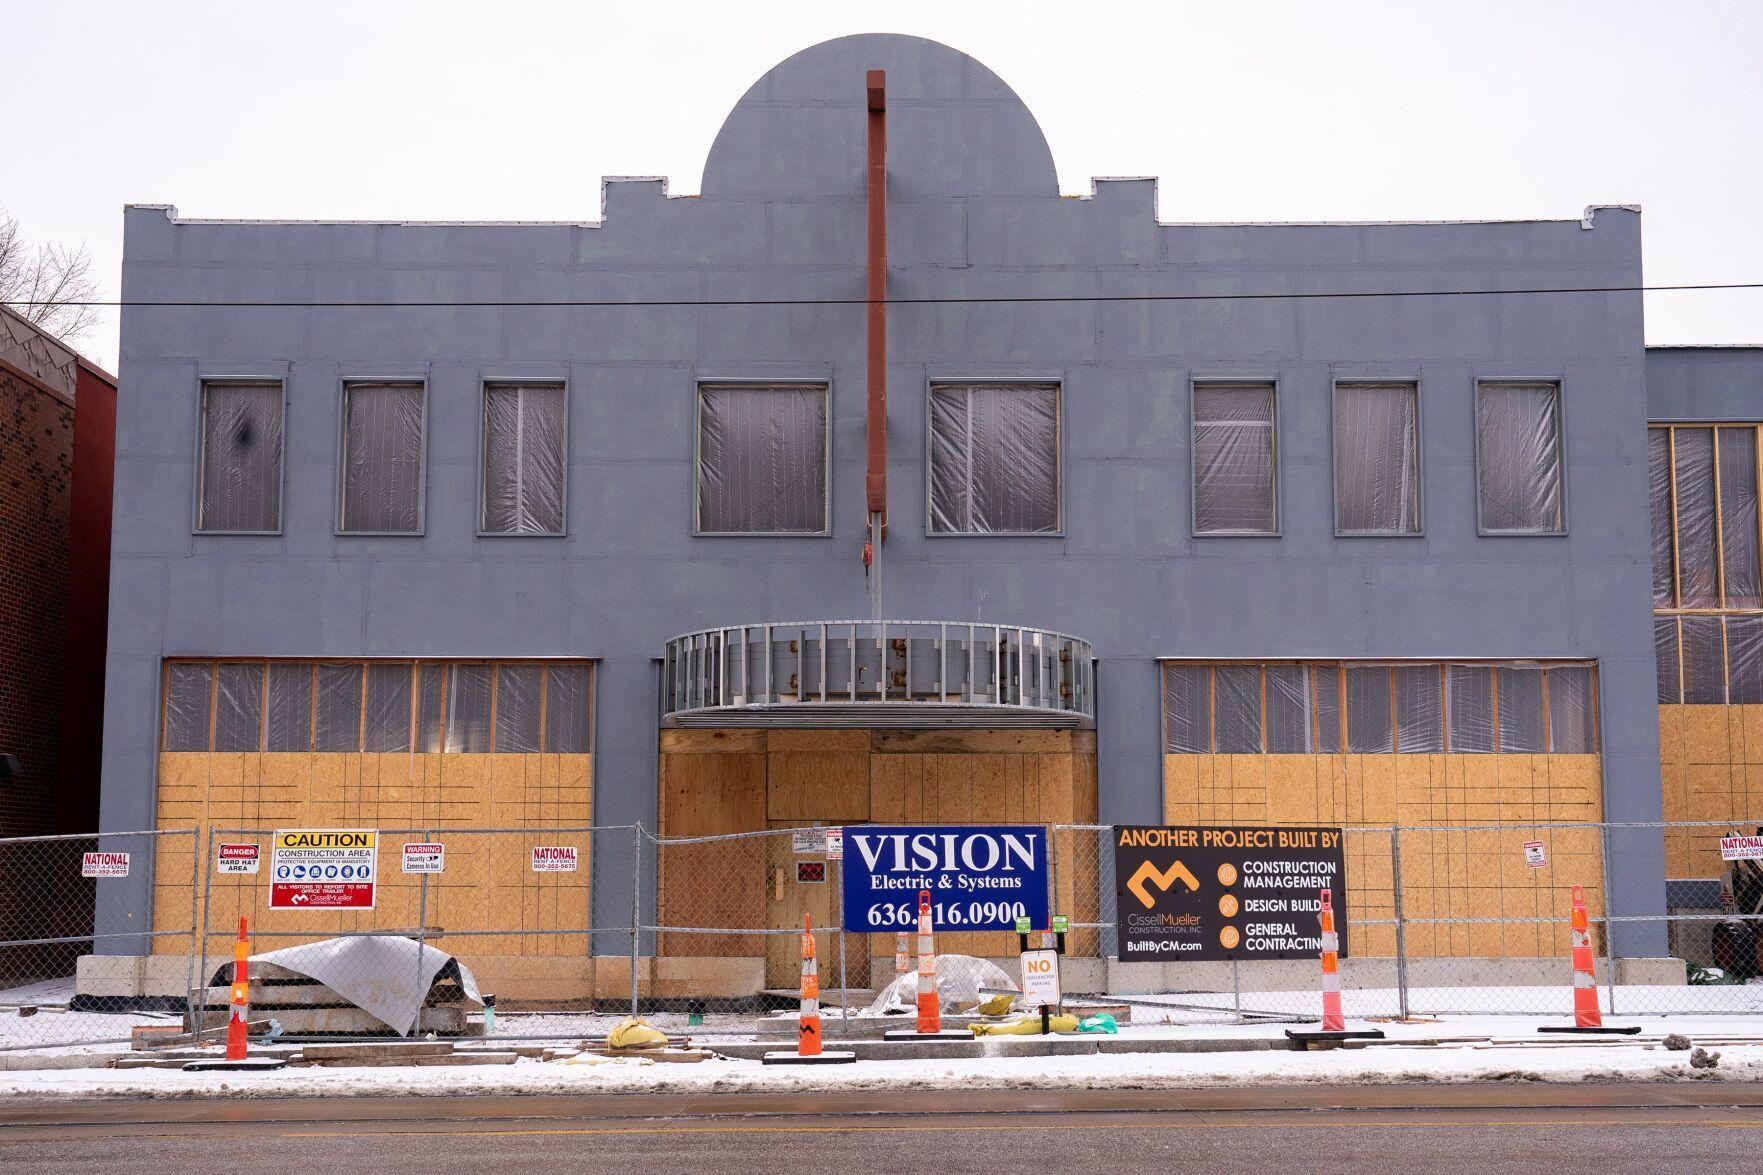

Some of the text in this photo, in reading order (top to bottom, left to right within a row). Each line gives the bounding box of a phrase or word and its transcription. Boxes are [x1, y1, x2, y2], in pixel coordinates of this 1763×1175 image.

[284, 834, 368, 847] CAUTION
[1119, 829, 1339, 848] ANOTHER PROJECT BUILT BY
[1722, 838, 1763, 849] NATIONAL
[84, 853, 128, 865] NATIONAL
[534, 848, 575, 859] NATIONAL
[851, 834, 1037, 872] VISION
[1243, 861, 1336, 874] CONSTRUCTION
[870, 874, 1022, 892] Electric & Systems
[1244, 876, 1332, 888] MANAGEMENT
[1245, 899, 1322, 912] DESIGN BUILD
[867, 901, 1026, 926] 636.16.0900
[1127, 913, 1202, 926] CissellMueller
[1189, 926, 1203, 934] INC
[1245, 923, 1298, 936] GENERAL
[1127, 940, 1203, 954] BuiltByCM.com
[1245, 937, 1326, 951] CONTRACTIN
[1027, 960, 1052, 974] NO
